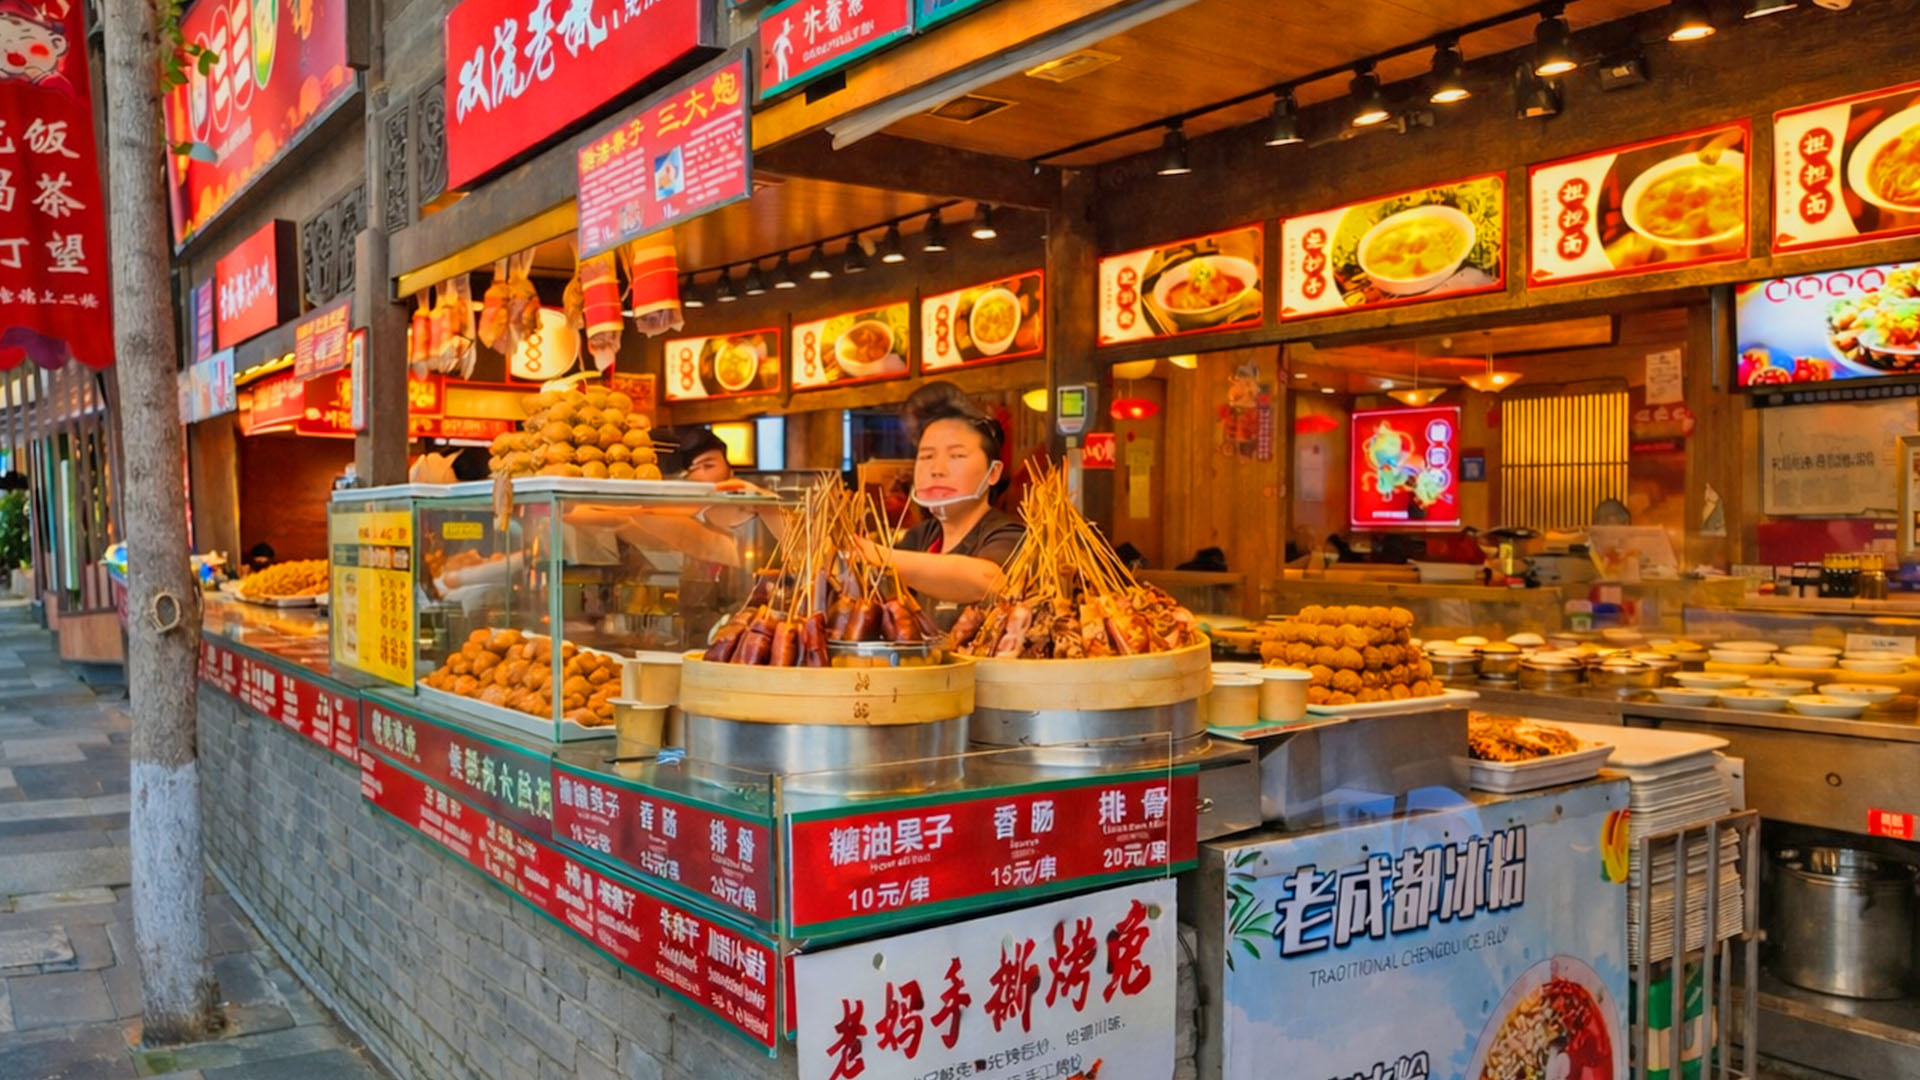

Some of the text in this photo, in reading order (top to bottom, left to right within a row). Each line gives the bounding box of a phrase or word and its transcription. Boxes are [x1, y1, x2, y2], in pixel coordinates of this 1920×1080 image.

[656, 72, 741, 138] 三大炮
[1802, 132, 1830, 216] 担担面
[993, 799, 1055, 840] 香肠
[1098, 786, 1169, 825] 排骨
[829, 813, 954, 867] 糖油果子
[848, 877, 931, 912] 10元/串
